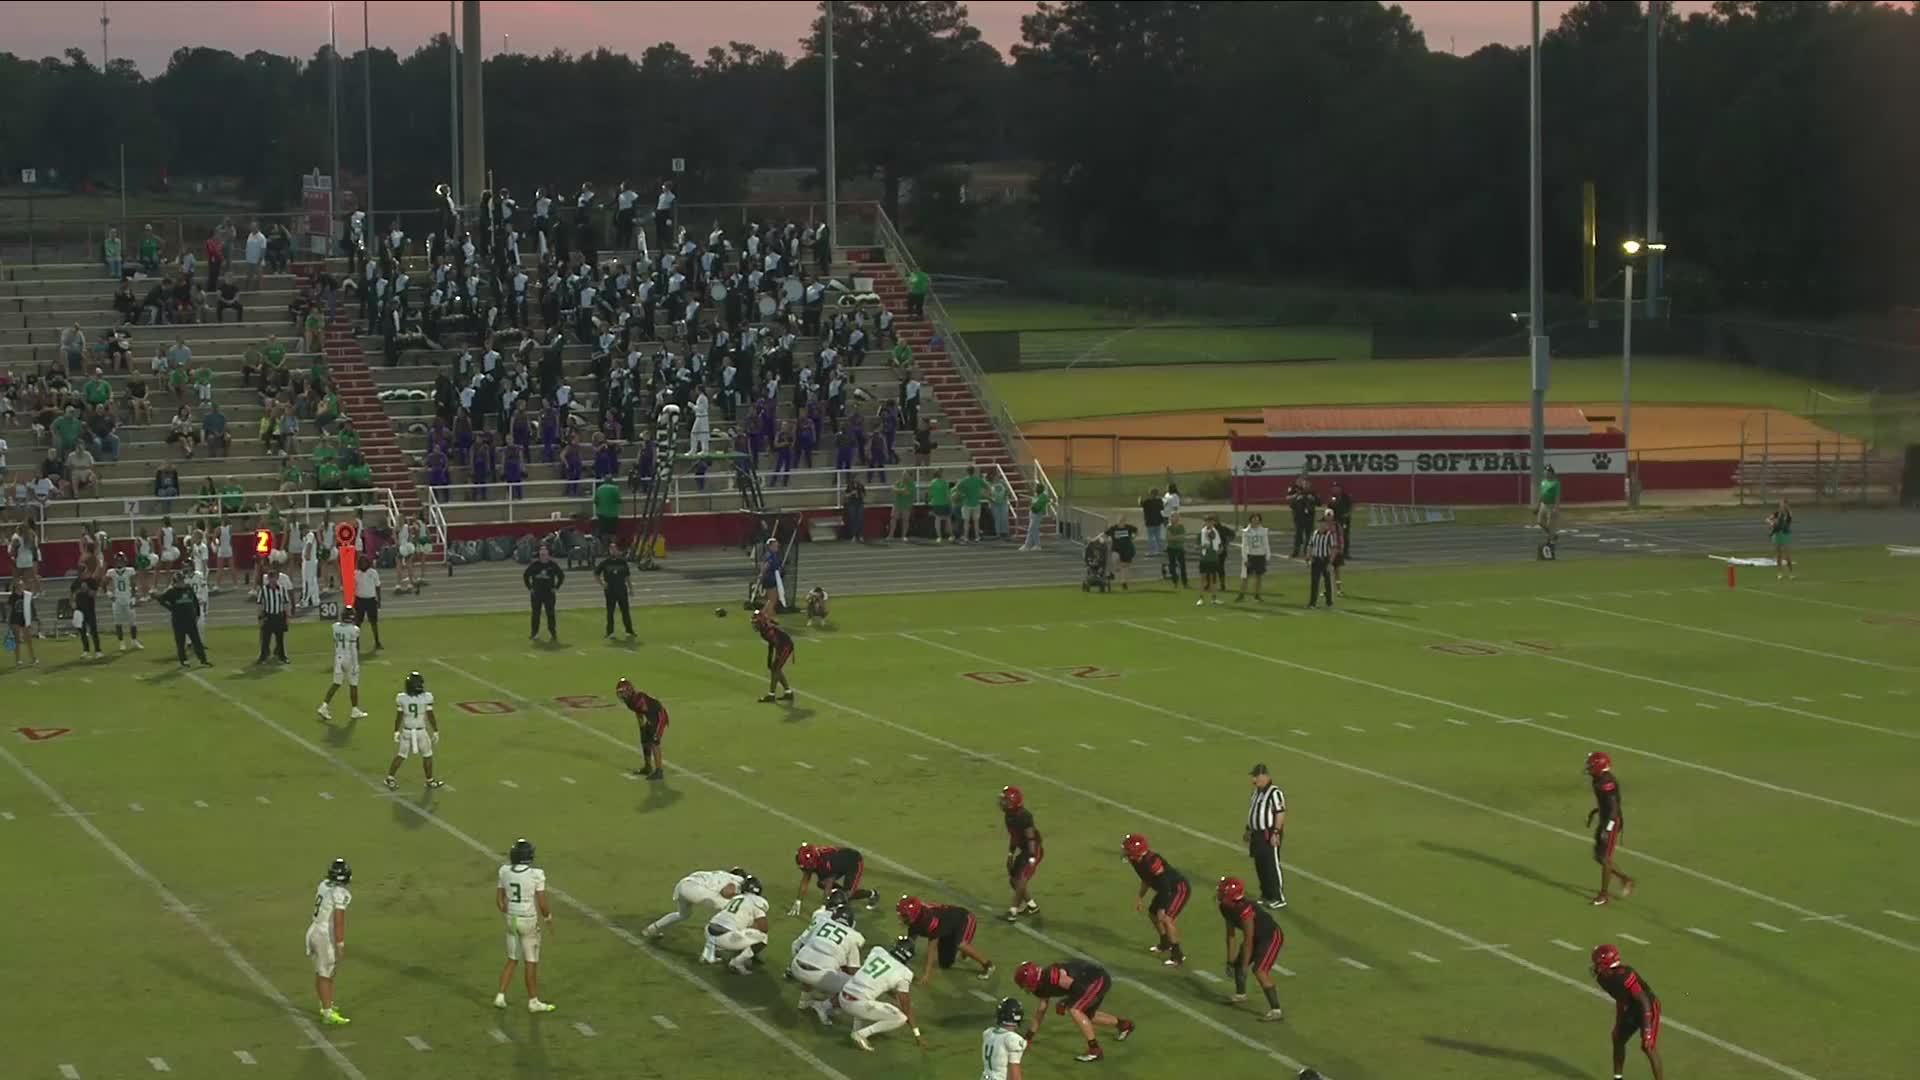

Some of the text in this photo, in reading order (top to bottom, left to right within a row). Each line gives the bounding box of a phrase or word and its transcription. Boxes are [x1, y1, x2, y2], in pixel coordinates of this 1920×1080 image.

[1305, 452, 1546, 472] DAWGS SOFTBAL
[256, 530, 269, 552] 2
[117, 580, 127, 592] 0
[320, 602, 338, 617] 30
[408, 703, 419, 718] 9
[510, 882, 521, 903] 3
[816, 922, 849, 945] 65
[863, 956, 896, 979] 51
[985, 1043, 996, 1071] 4
